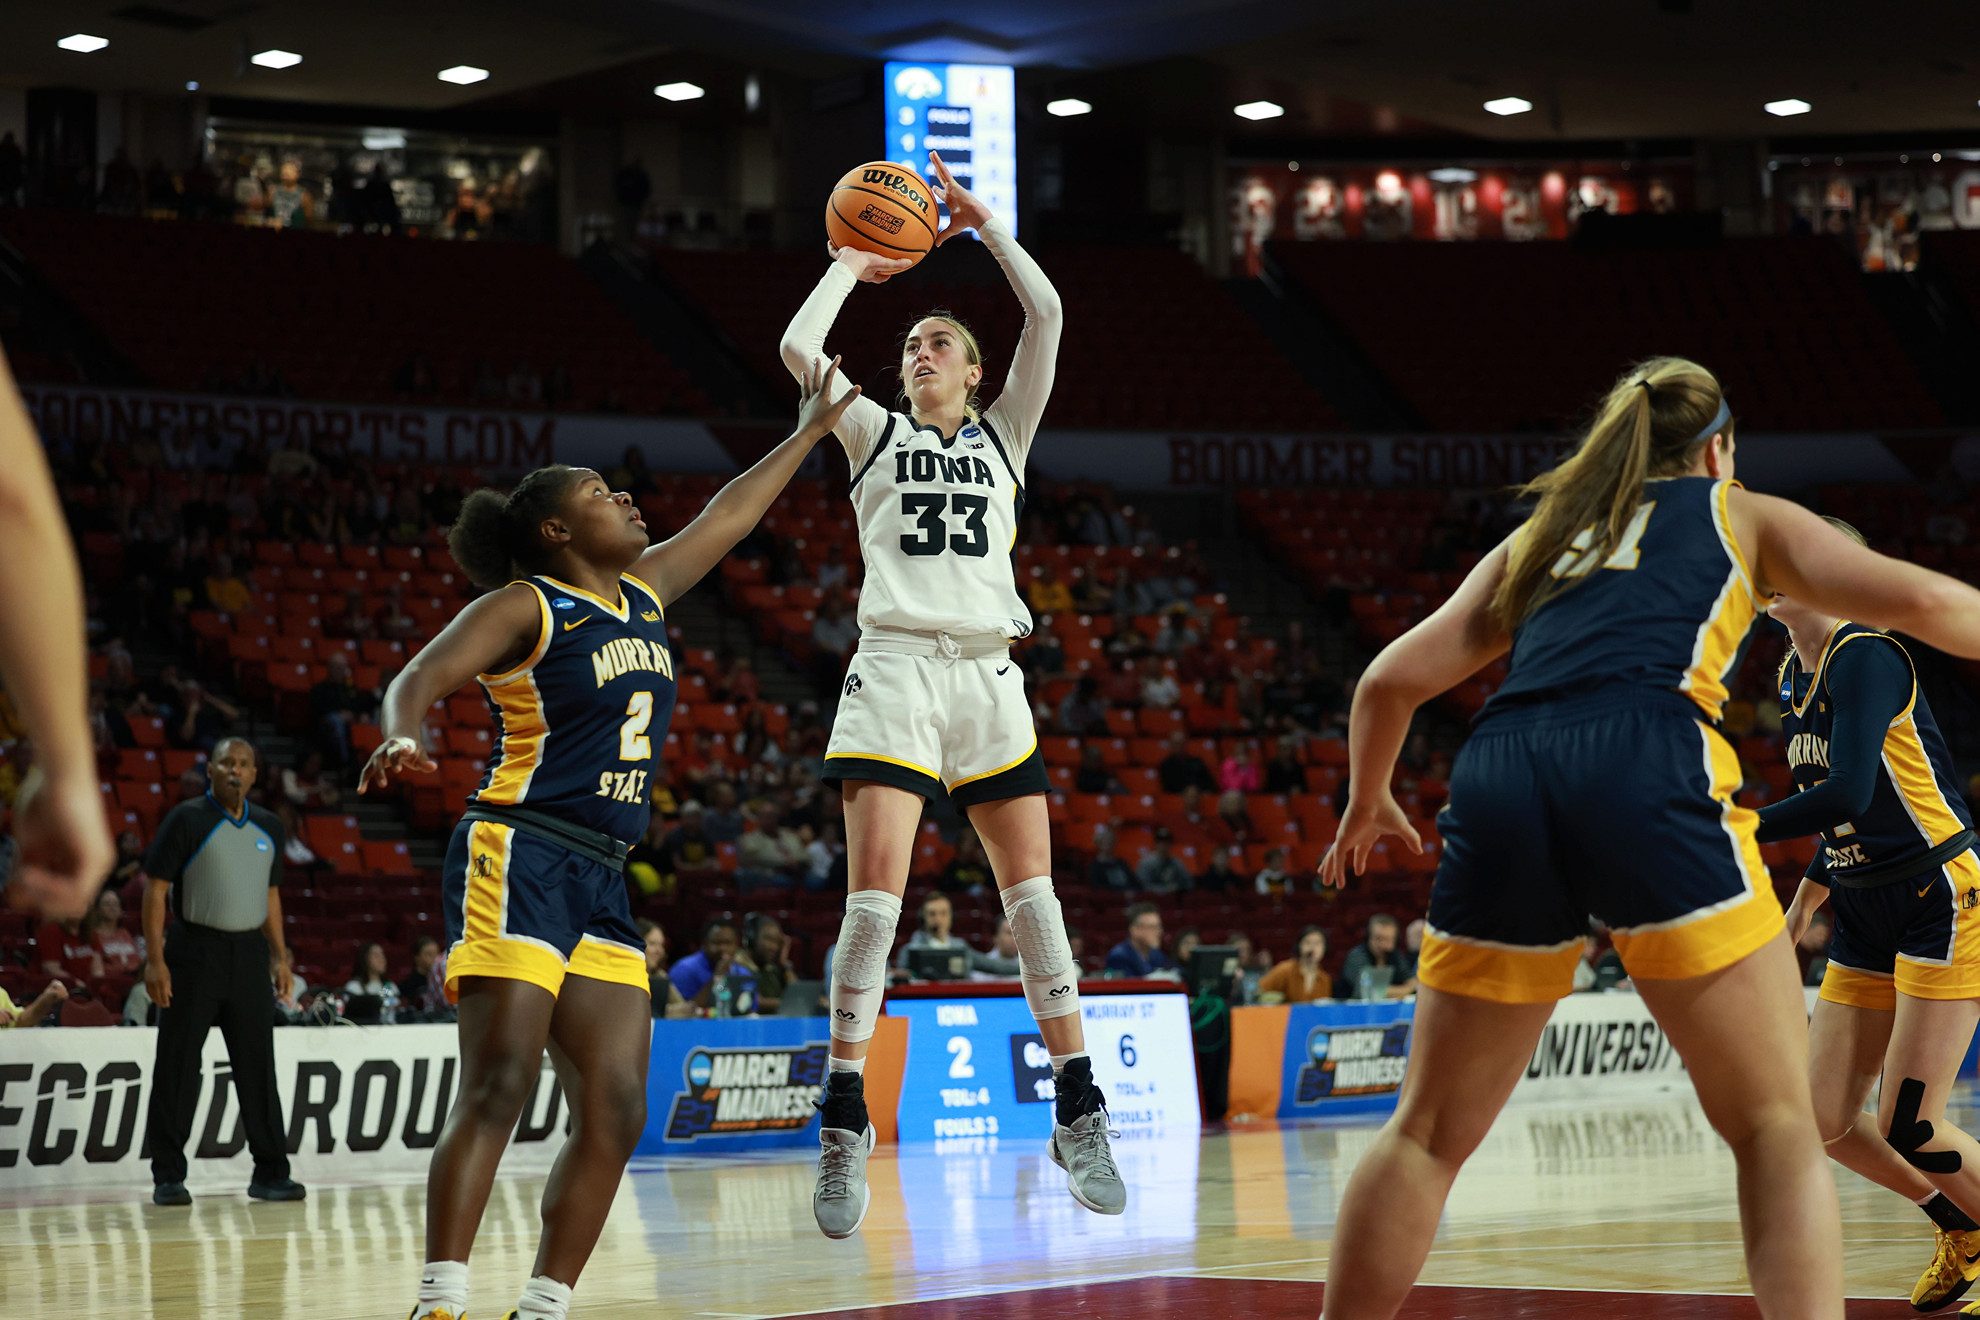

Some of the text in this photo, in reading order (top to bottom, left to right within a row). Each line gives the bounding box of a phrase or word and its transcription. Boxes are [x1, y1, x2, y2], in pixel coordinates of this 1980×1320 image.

[862, 170, 929, 214] Wilson
[870, 215, 900, 233] MADNESS
[872, 208, 893, 222] MARCH
[895, 449, 995, 488] IOWA
[1169, 440, 1372, 486] BOOMER
[900, 493, 988, 558] 33
[592, 637, 674, 689] MURRAY
[619, 691, 654, 762] 2
[937, 1005, 978, 1026] IOWA
[1083, 1004, 1134, 1019] MURRAY
[947, 1036, 975, 1078] 2
[1119, 1034, 1136, 1068] 6
[1327, 1030, 1385, 1061] MARCH
[710, 1053, 791, 1088] MARCH
[1333, 1056, 1407, 1089] MADNESS
[715, 1085, 822, 1121] MADNESS
[934, 1116, 998, 1137] FOULS 3
